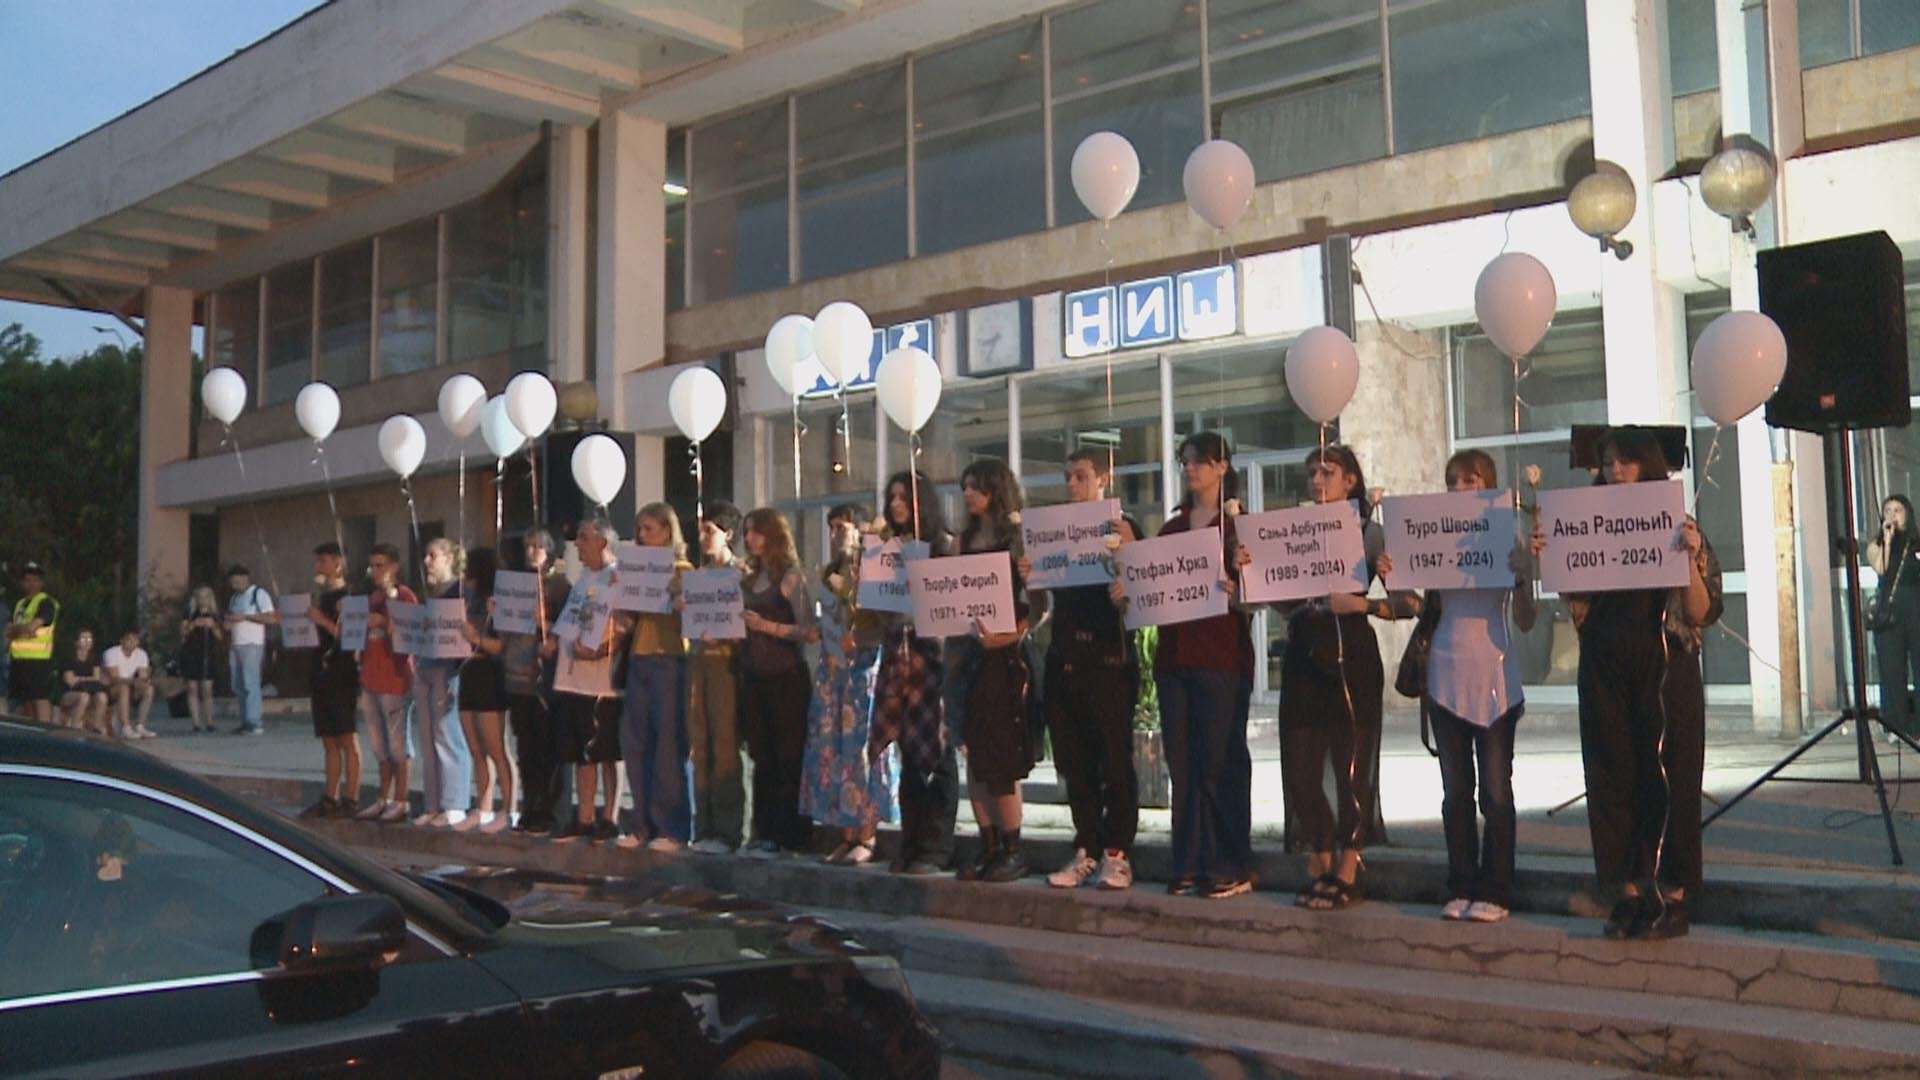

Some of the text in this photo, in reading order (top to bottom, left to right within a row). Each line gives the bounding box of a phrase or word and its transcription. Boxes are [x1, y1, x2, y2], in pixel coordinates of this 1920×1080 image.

[1073, 267, 1231, 347] НИШ
[1258, 518, 1342, 541] Сања Арбутина
[1404, 516, 1490, 539] Ђуро Швоња
[1553, 510, 1673, 537] Ања Радоњић
[1284, 539, 1320, 557] Ћирић
[1566, 549, 1605, 571] (2001
[1621, 547, 1663, 568] 2024)
[1126, 556, 1209, 581] Стефан Хрка
[1409, 552, 1443, 572] (1947
[1456, 549, 1494, 569] 2024)
[922, 572, 999, 593] Ђорђе Фирић
[1264, 564, 1299, 585] (1989
[1137, 591, 1164, 610] (1997
[1177, 584, 1209, 602] 2024)
[930, 607, 956, 622] (1971
[967, 603, 997, 619] 2024)
